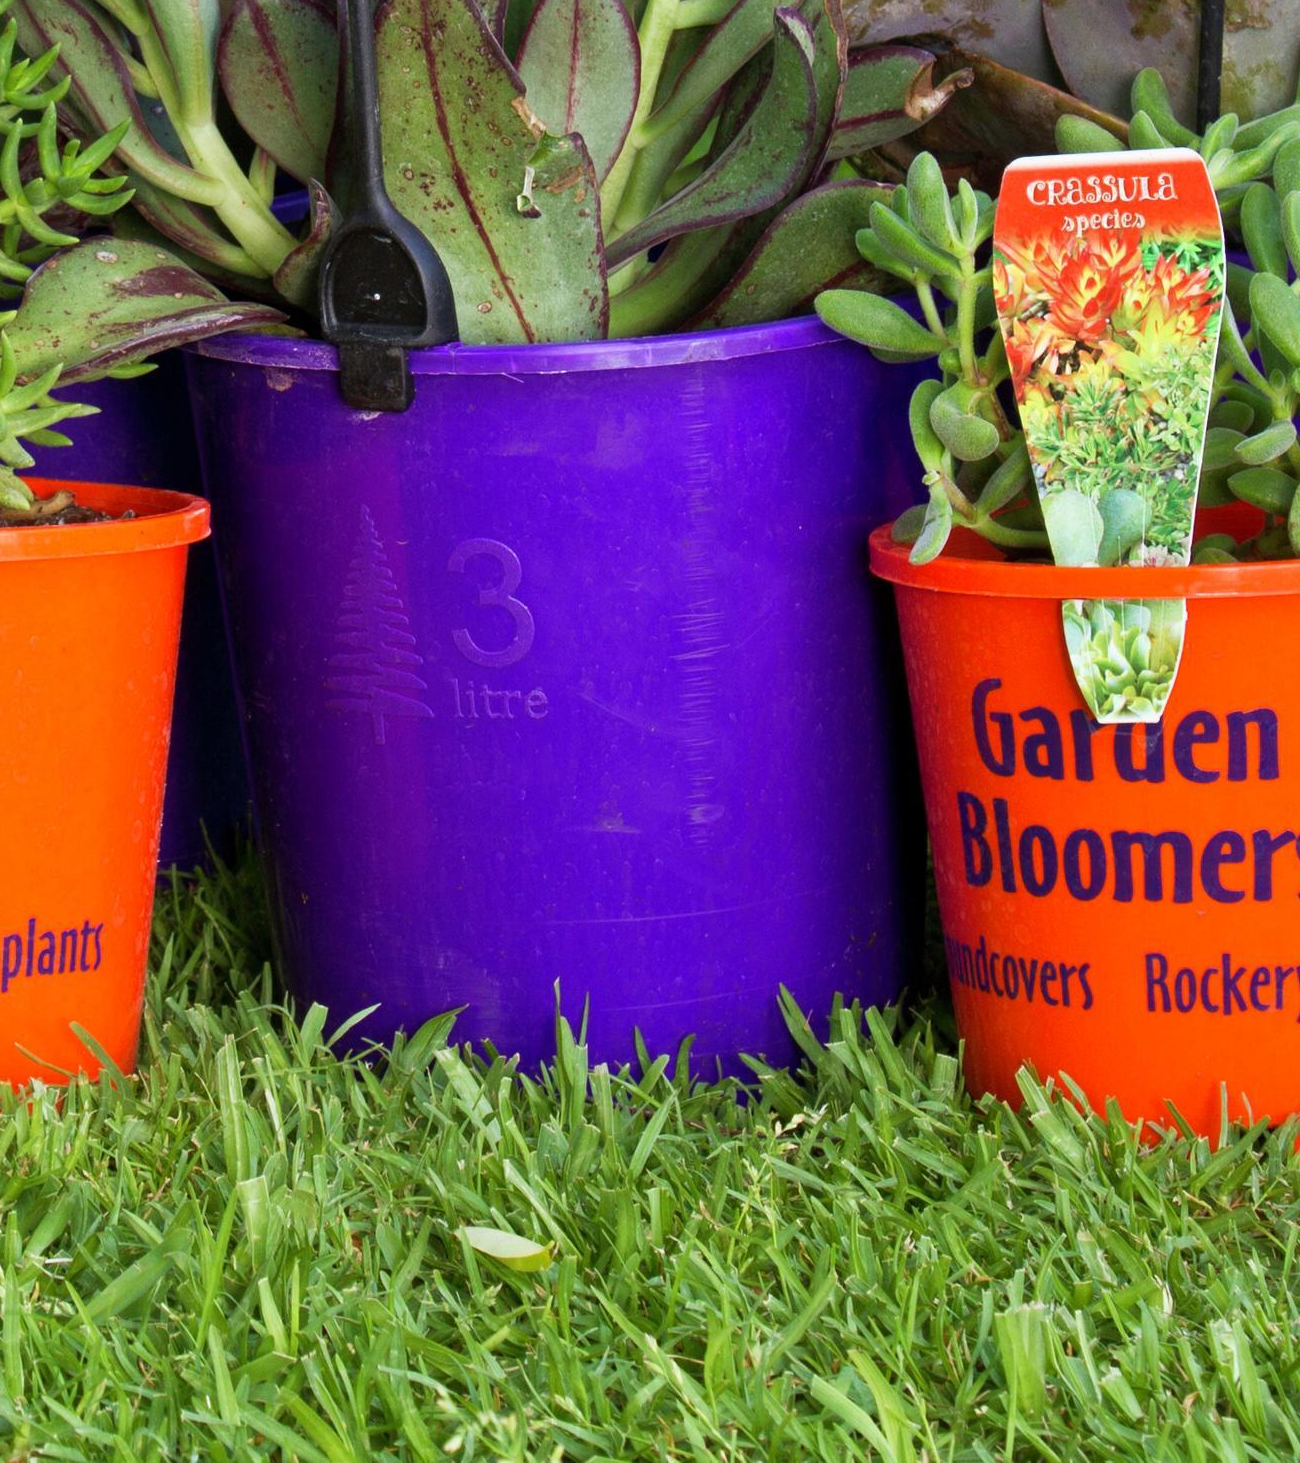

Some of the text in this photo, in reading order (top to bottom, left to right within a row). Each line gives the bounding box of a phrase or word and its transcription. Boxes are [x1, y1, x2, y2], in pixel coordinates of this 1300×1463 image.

[1060, 208, 1147, 239] species
[447, 537, 536, 669] 3
[450, 677, 550, 719] litre
[970, 676, 1280, 785] Garden
[0, 916, 105, 994] plants
